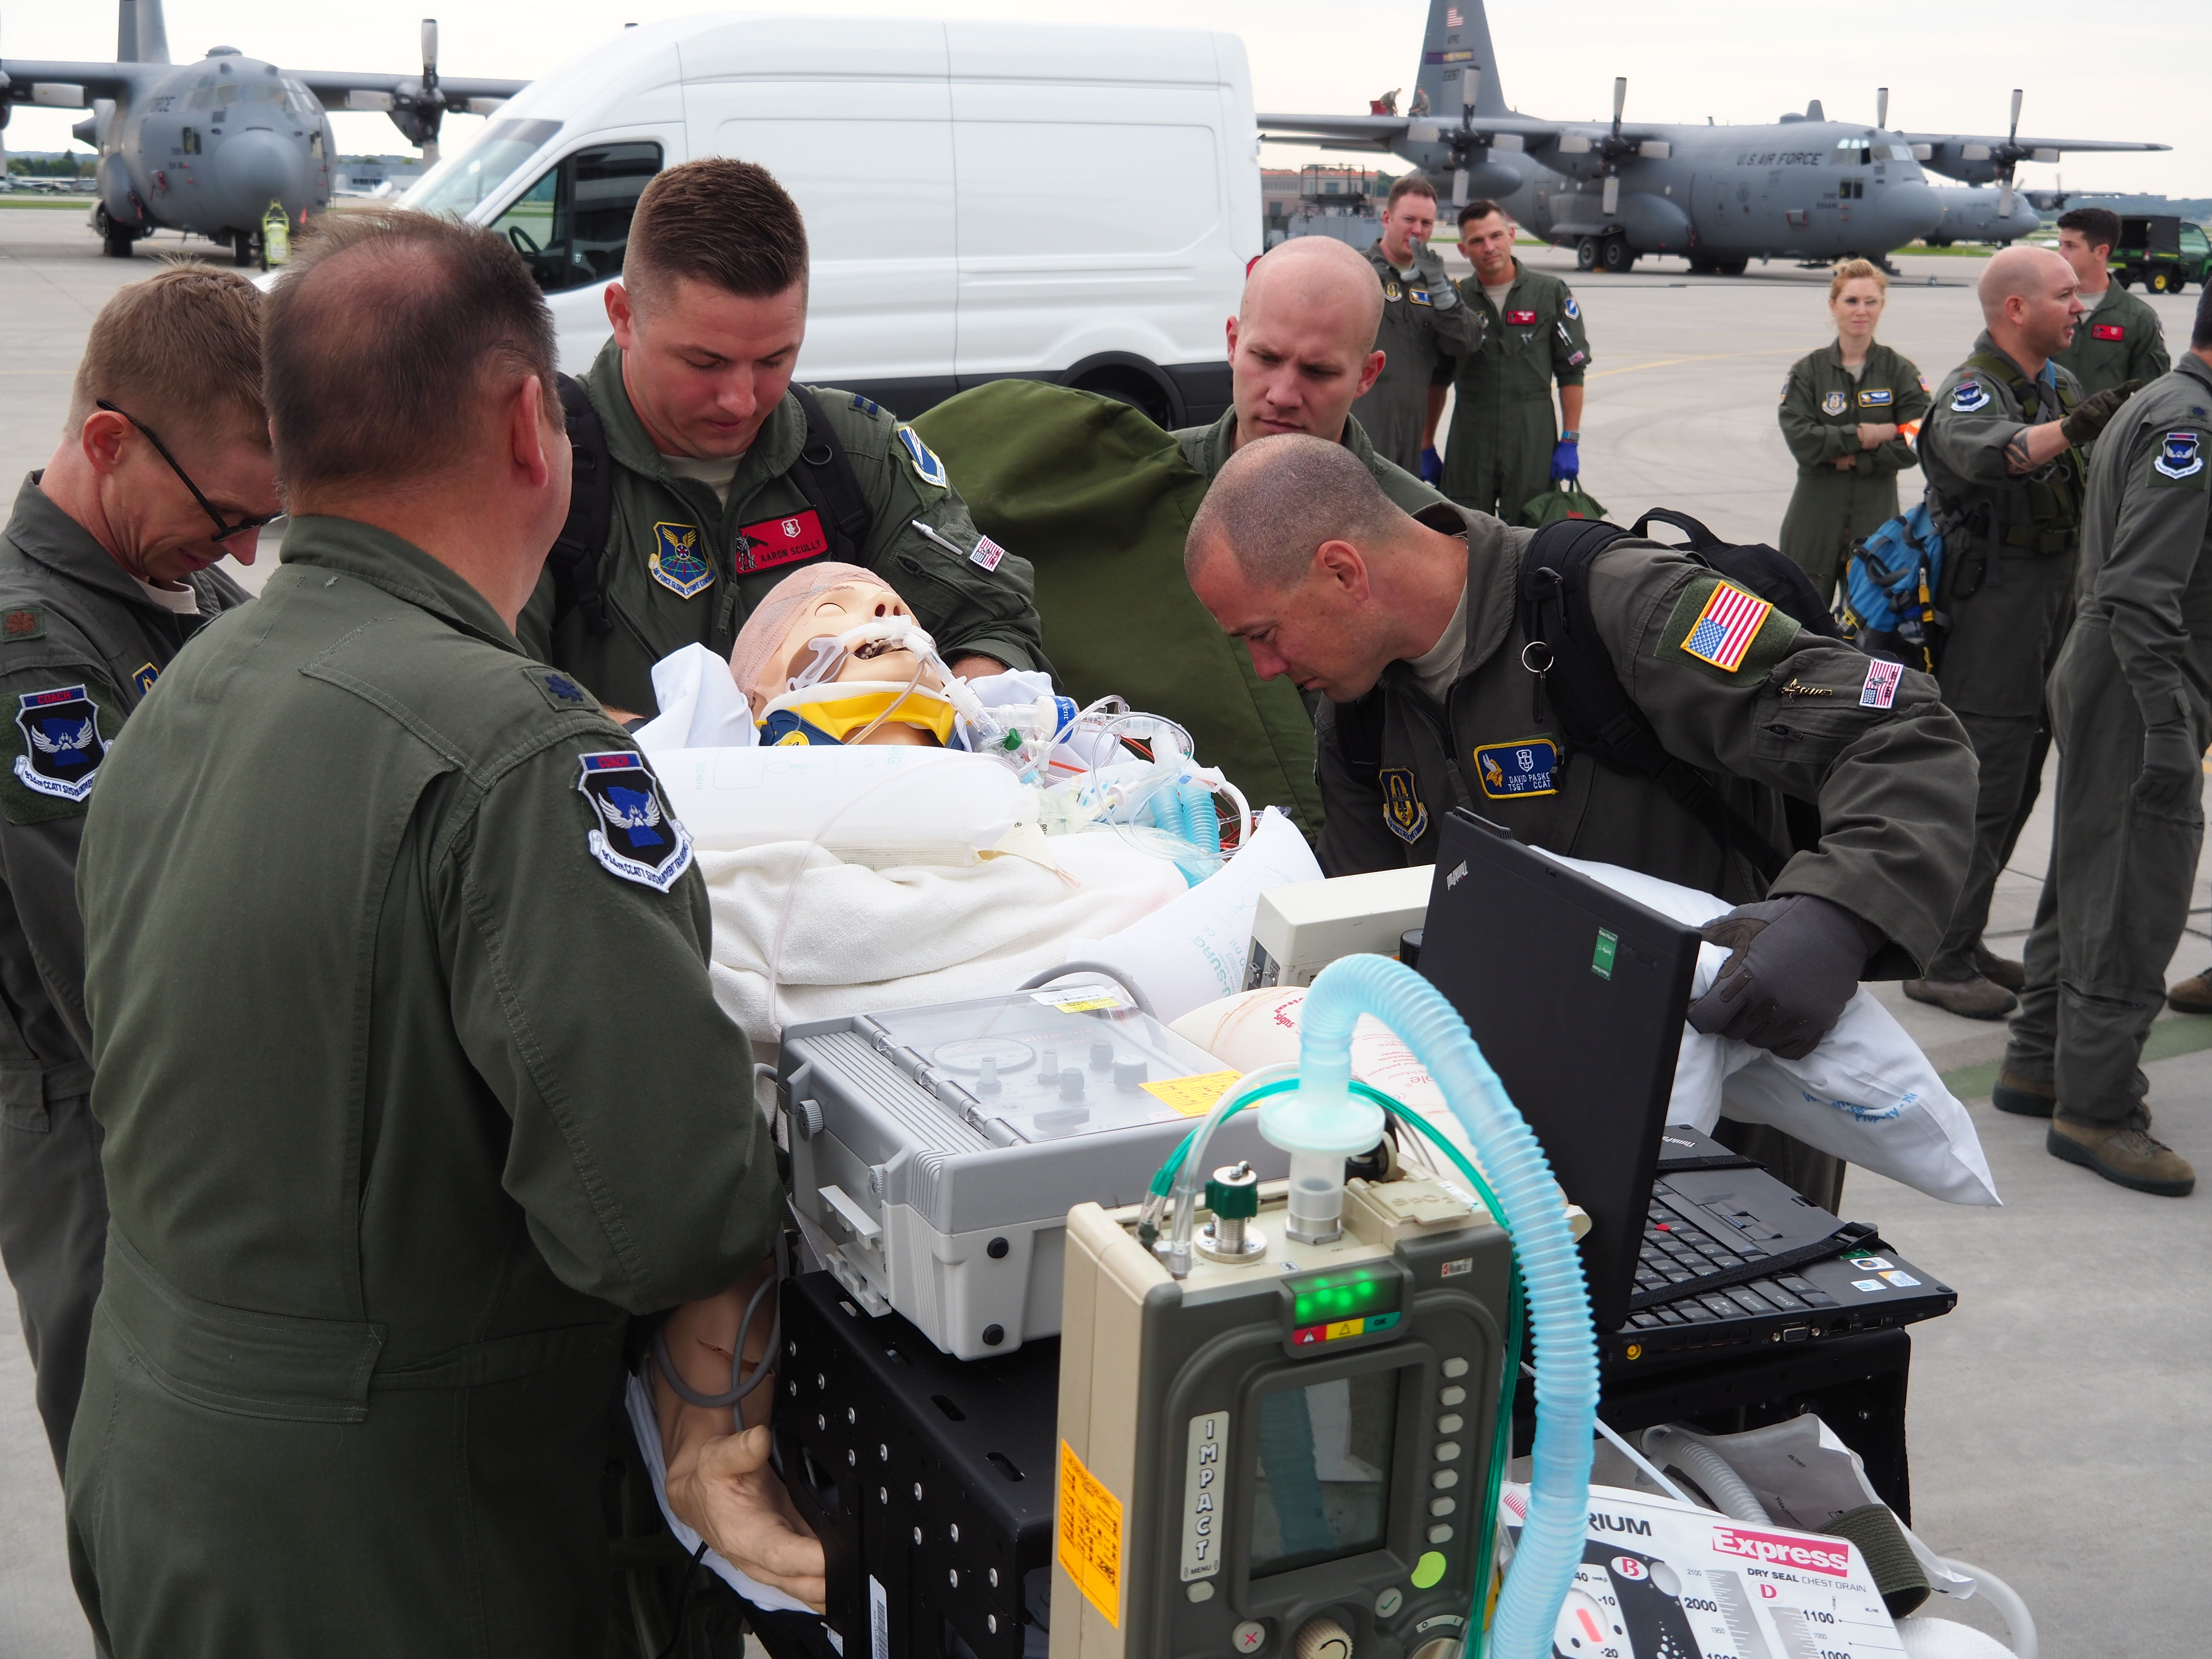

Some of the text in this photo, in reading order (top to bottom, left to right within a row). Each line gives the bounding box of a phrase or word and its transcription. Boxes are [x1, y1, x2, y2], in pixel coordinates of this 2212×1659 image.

[1758, 153, 1776, 166] AIR
[1776, 152, 1823, 166] FORCE
[761, 539, 821, 563] AARON SCULLY
[658, 574, 671, 586] FORCE
[672, 581, 687, 596] GLOBAL
[686, 582, 700, 596] STRIKE
[37, 691, 72, 704] COACH
[43, 780, 62, 792] CCATT
[1509, 774, 1527, 784] DAVID
[1508, 783, 1525, 792] TSGT
[625, 863, 646, 879] CCATT
[1447, 860, 1468, 891] ThinkPad
[1193, 936, 1231, 997] U-SURG
[1273, 1012, 1294, 1029] signs
[1662, 1135, 1697, 1148] ThinkPa
[1374, 1317, 1387, 1326] OK
[1196, 1419, 1218, 1560] IMPACT
[1589, 1512, 1652, 1537] RIUM
[1712, 1528, 1848, 1571] Express
[1190, 1564, 1212, 1575] MENU
[1621, 1557, 1639, 1577] B
[1687, 1568, 1703, 1577] 2100
[1746, 1567, 1866, 1593] DRY SEAL CHEST DRAIN
[1760, 1583, 1777, 1599] D
[1684, 1596, 1717, 1613] 2000
[1802, 1609, 1835, 1624] 1100
[1711, 1626, 1725, 1635] 1950
[1813, 1632, 1827, 1640] 1050
